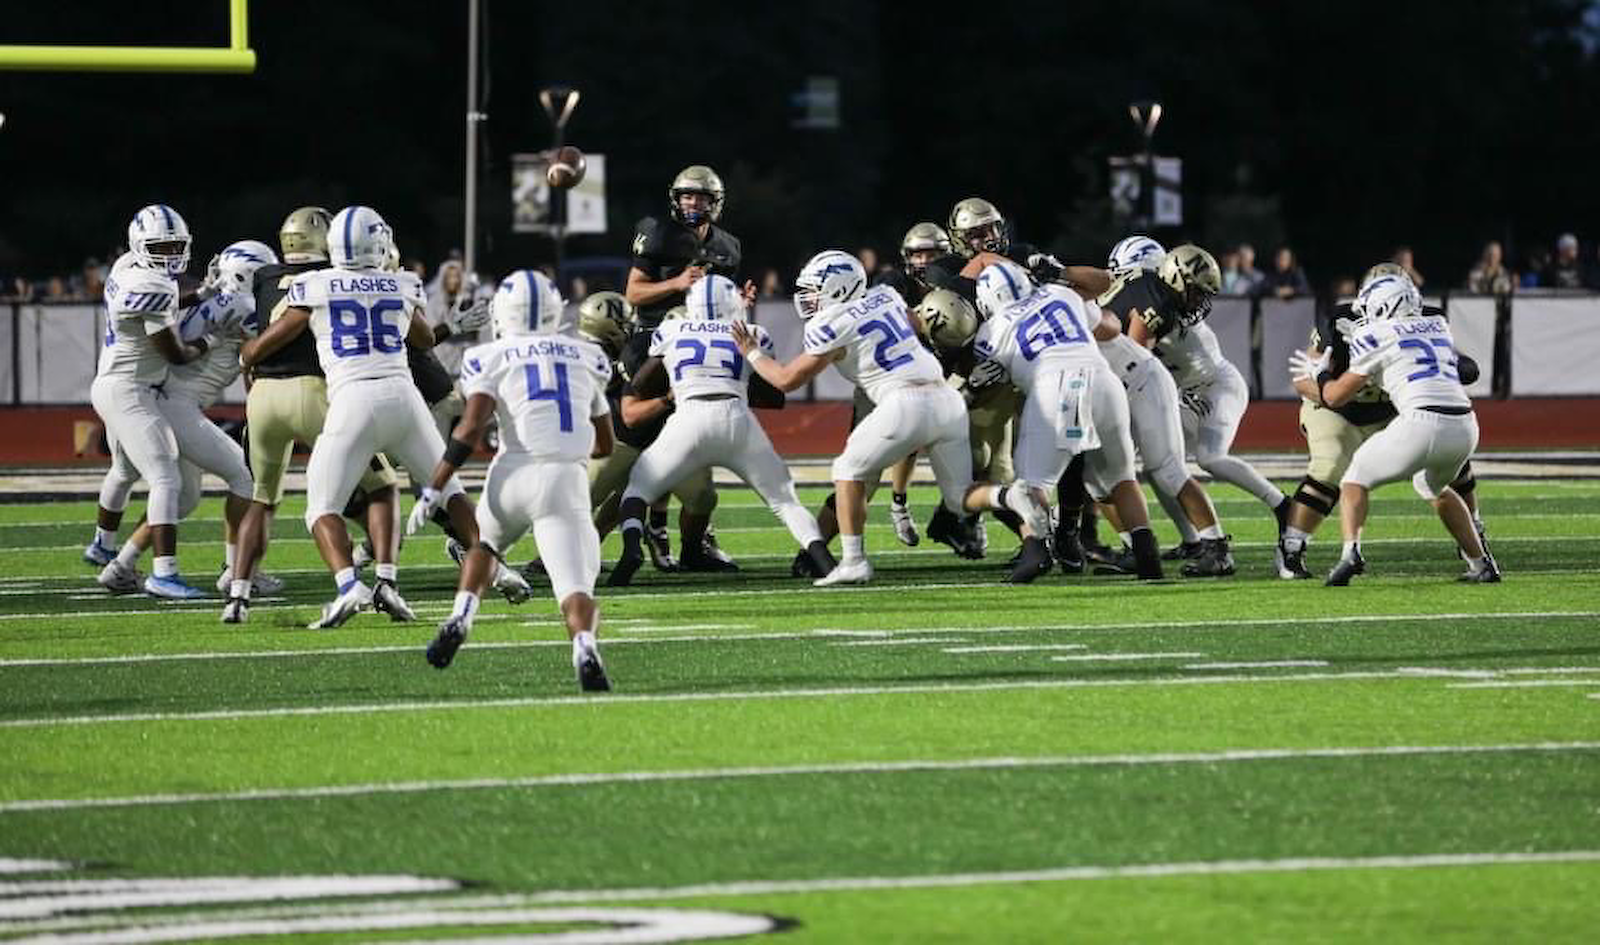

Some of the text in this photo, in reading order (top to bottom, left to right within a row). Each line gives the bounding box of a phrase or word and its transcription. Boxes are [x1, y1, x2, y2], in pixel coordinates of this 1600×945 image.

[330, 278, 398, 294] FLASHES
[329, 299, 404, 358] 86
[680, 322, 734, 334] FLASHE
[1016, 300, 1089, 362] 60
[1393, 319, 1446, 334] FLASHE
[504, 340, 581, 362] FLASHES
[674, 339, 744, 382] 23
[523, 362, 574, 433] 4
